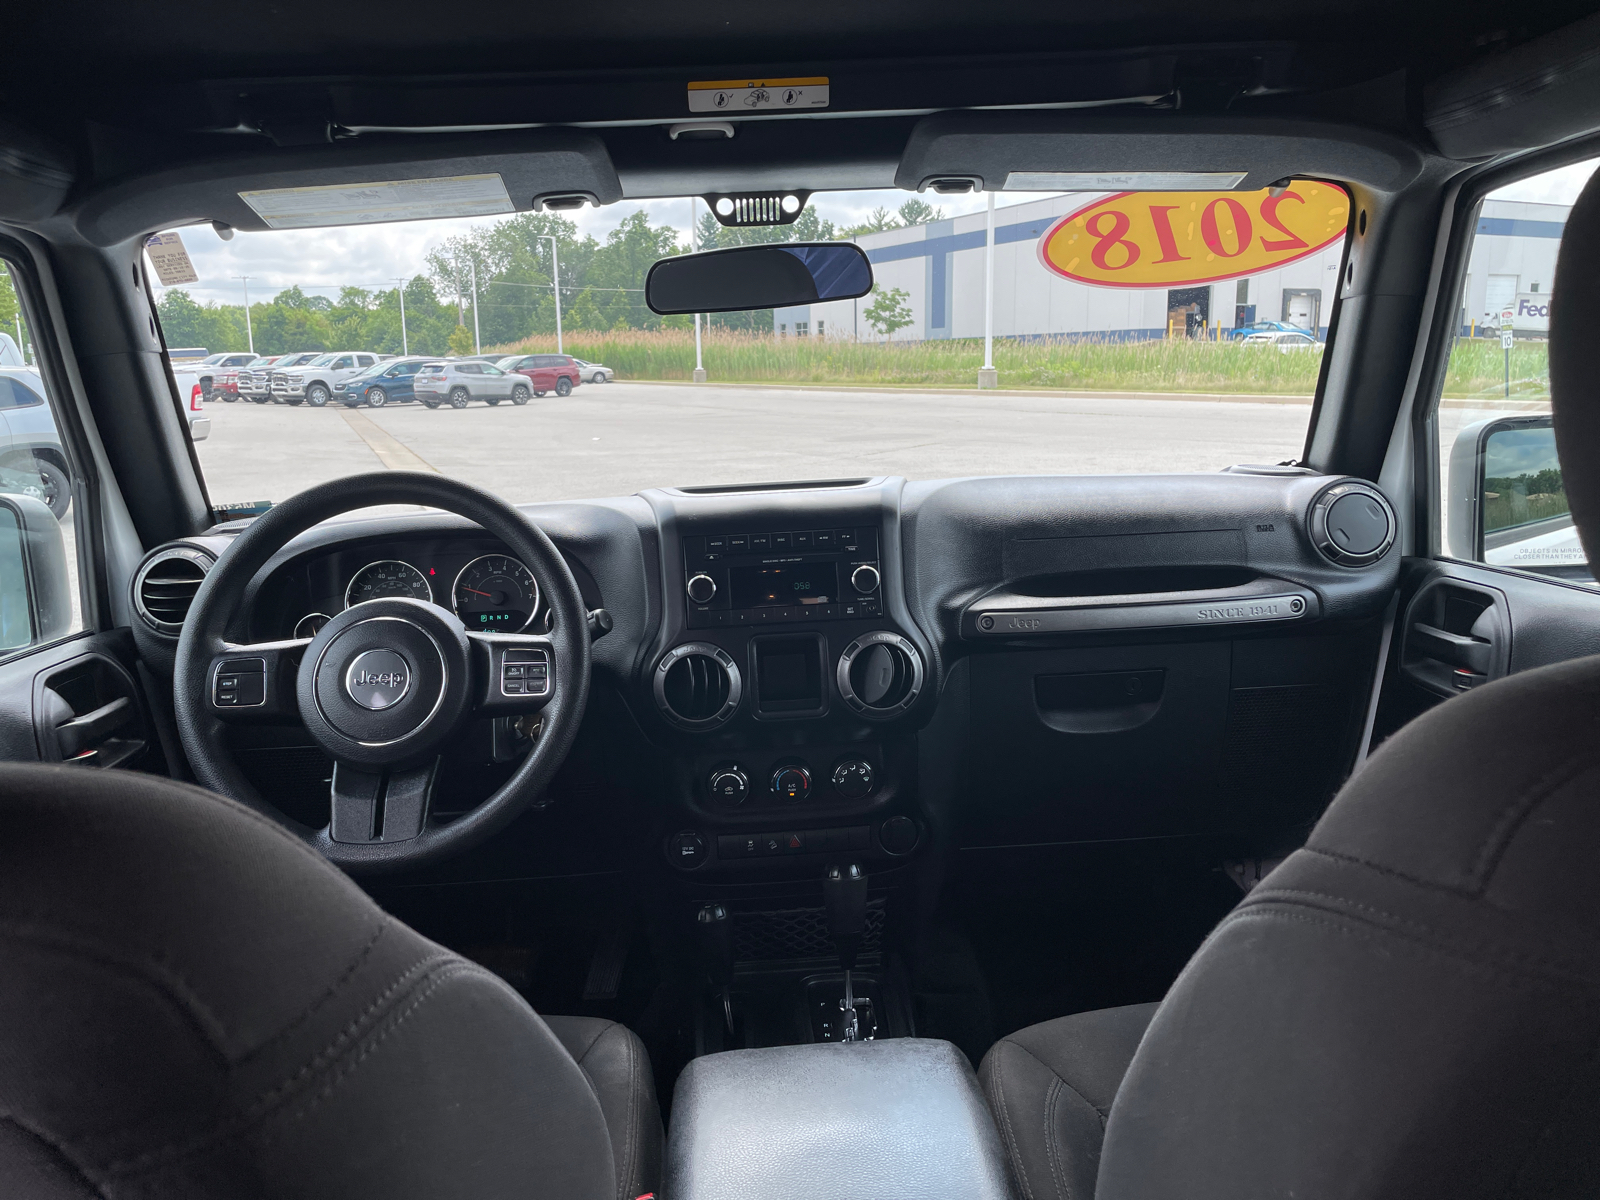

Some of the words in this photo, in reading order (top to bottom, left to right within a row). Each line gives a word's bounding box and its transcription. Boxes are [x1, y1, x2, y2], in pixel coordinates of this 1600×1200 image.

[1504, 336, 1512, 346] 10
[1197, 608, 1244, 620] SINCE
[1249, 605, 1278, 617] 1941
[1009, 616, 1041, 630] Jeep
[354, 670, 404, 688] Jeep
